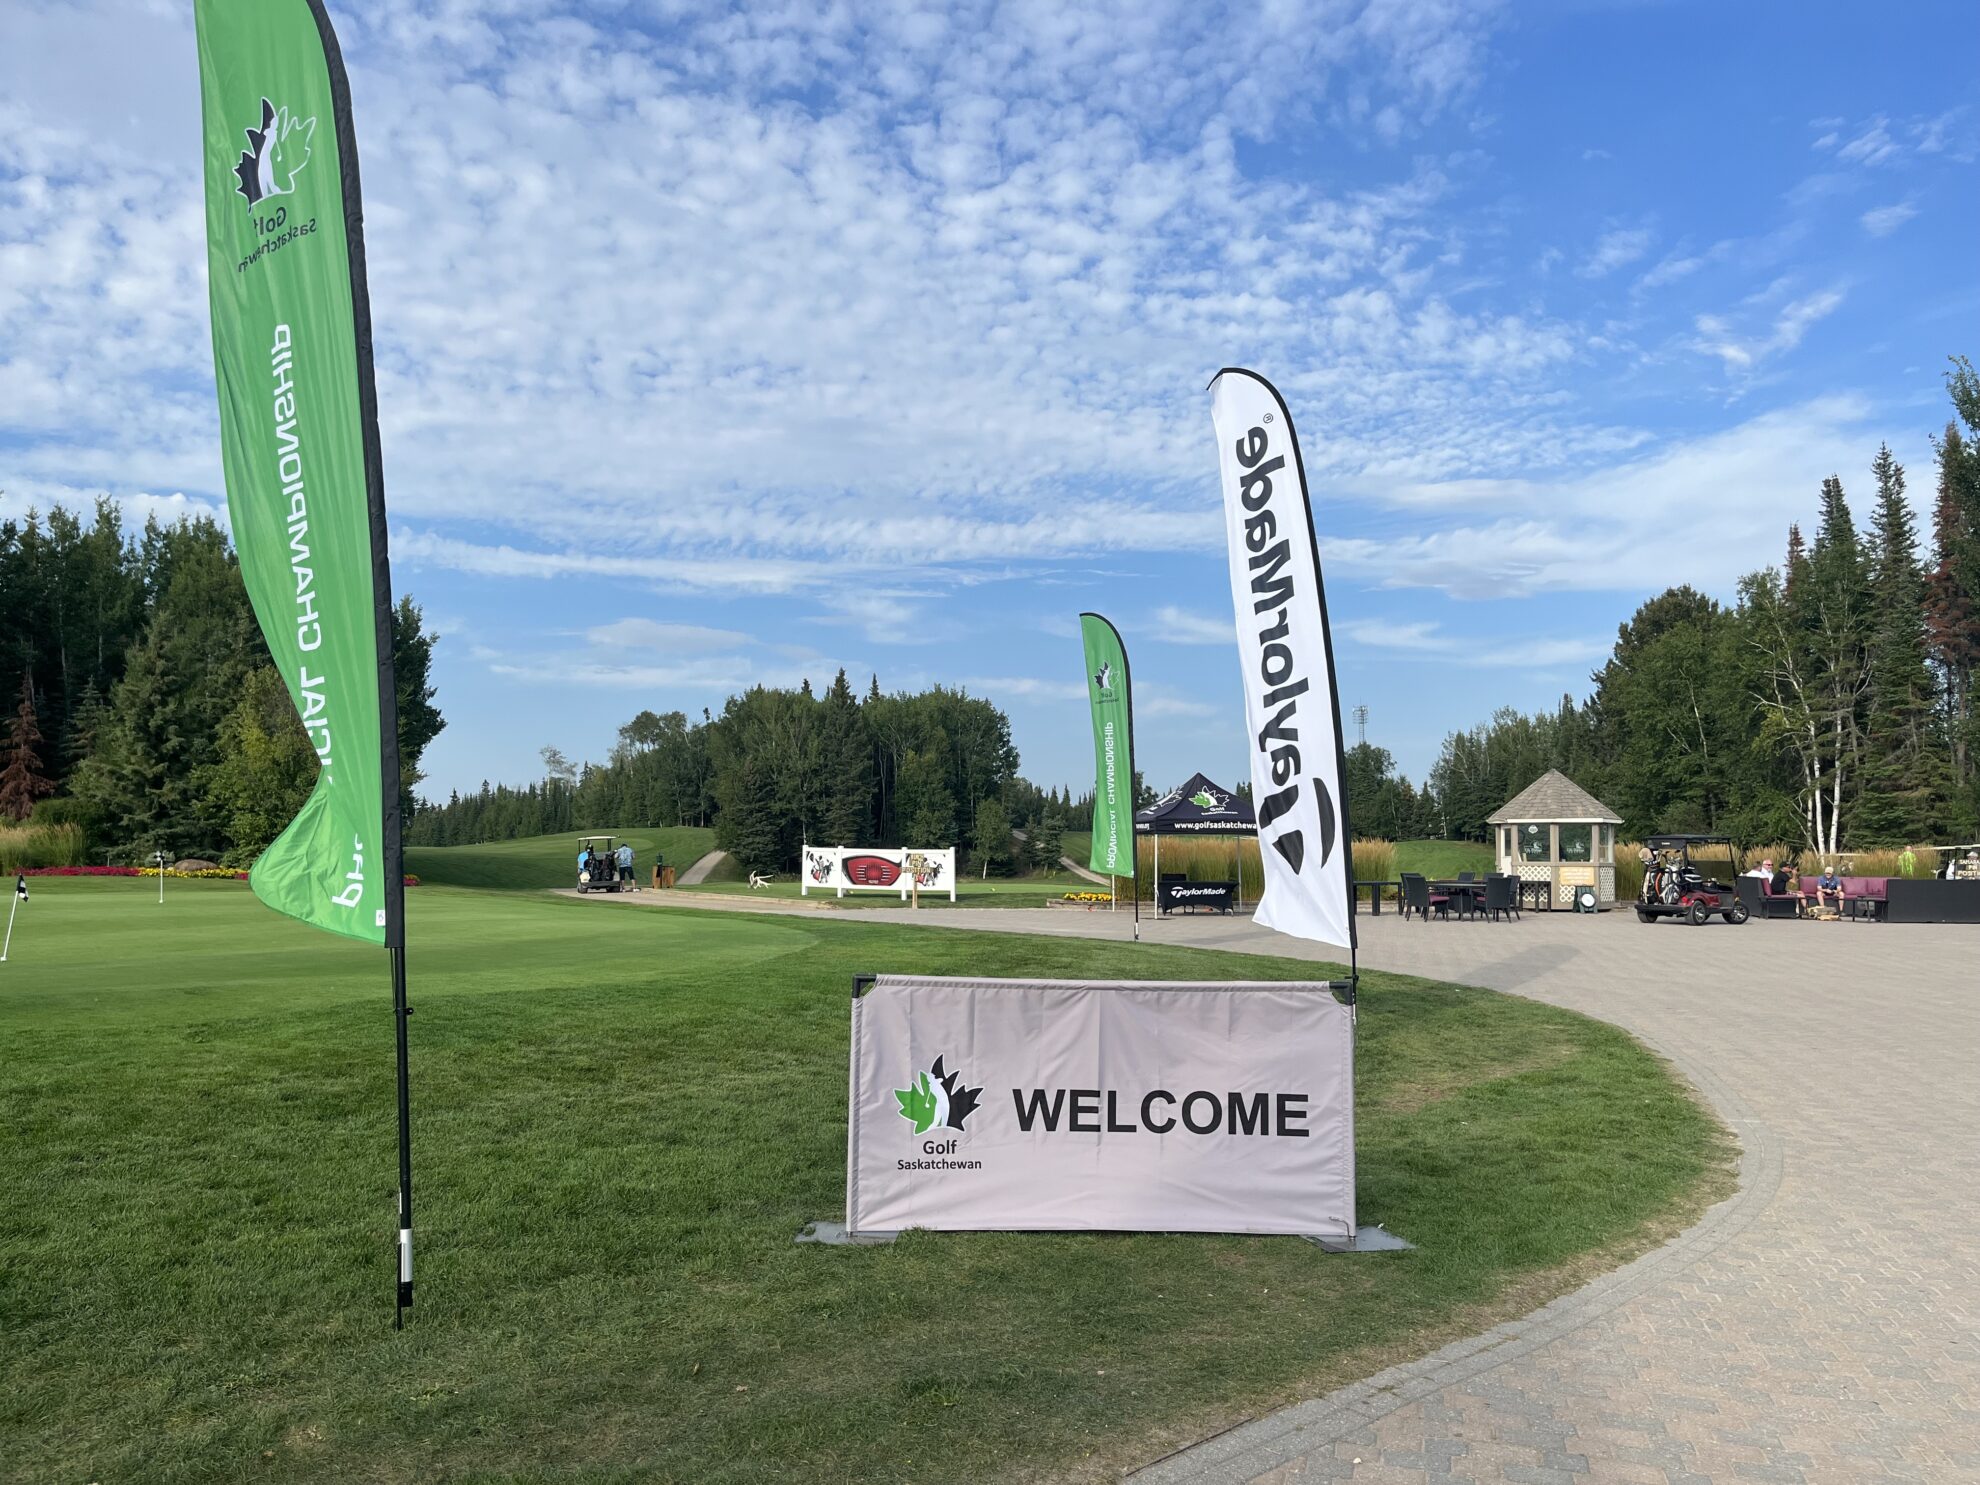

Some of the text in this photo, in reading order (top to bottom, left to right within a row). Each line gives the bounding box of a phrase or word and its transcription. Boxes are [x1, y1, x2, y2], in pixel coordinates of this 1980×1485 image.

[1170, 886, 1226, 899] TaylorMade
[1012, 1088, 1310, 1138] WELCOME
[922, 1140, 958, 1156] Golf
[897, 1157, 982, 1170] Saskatchewan
